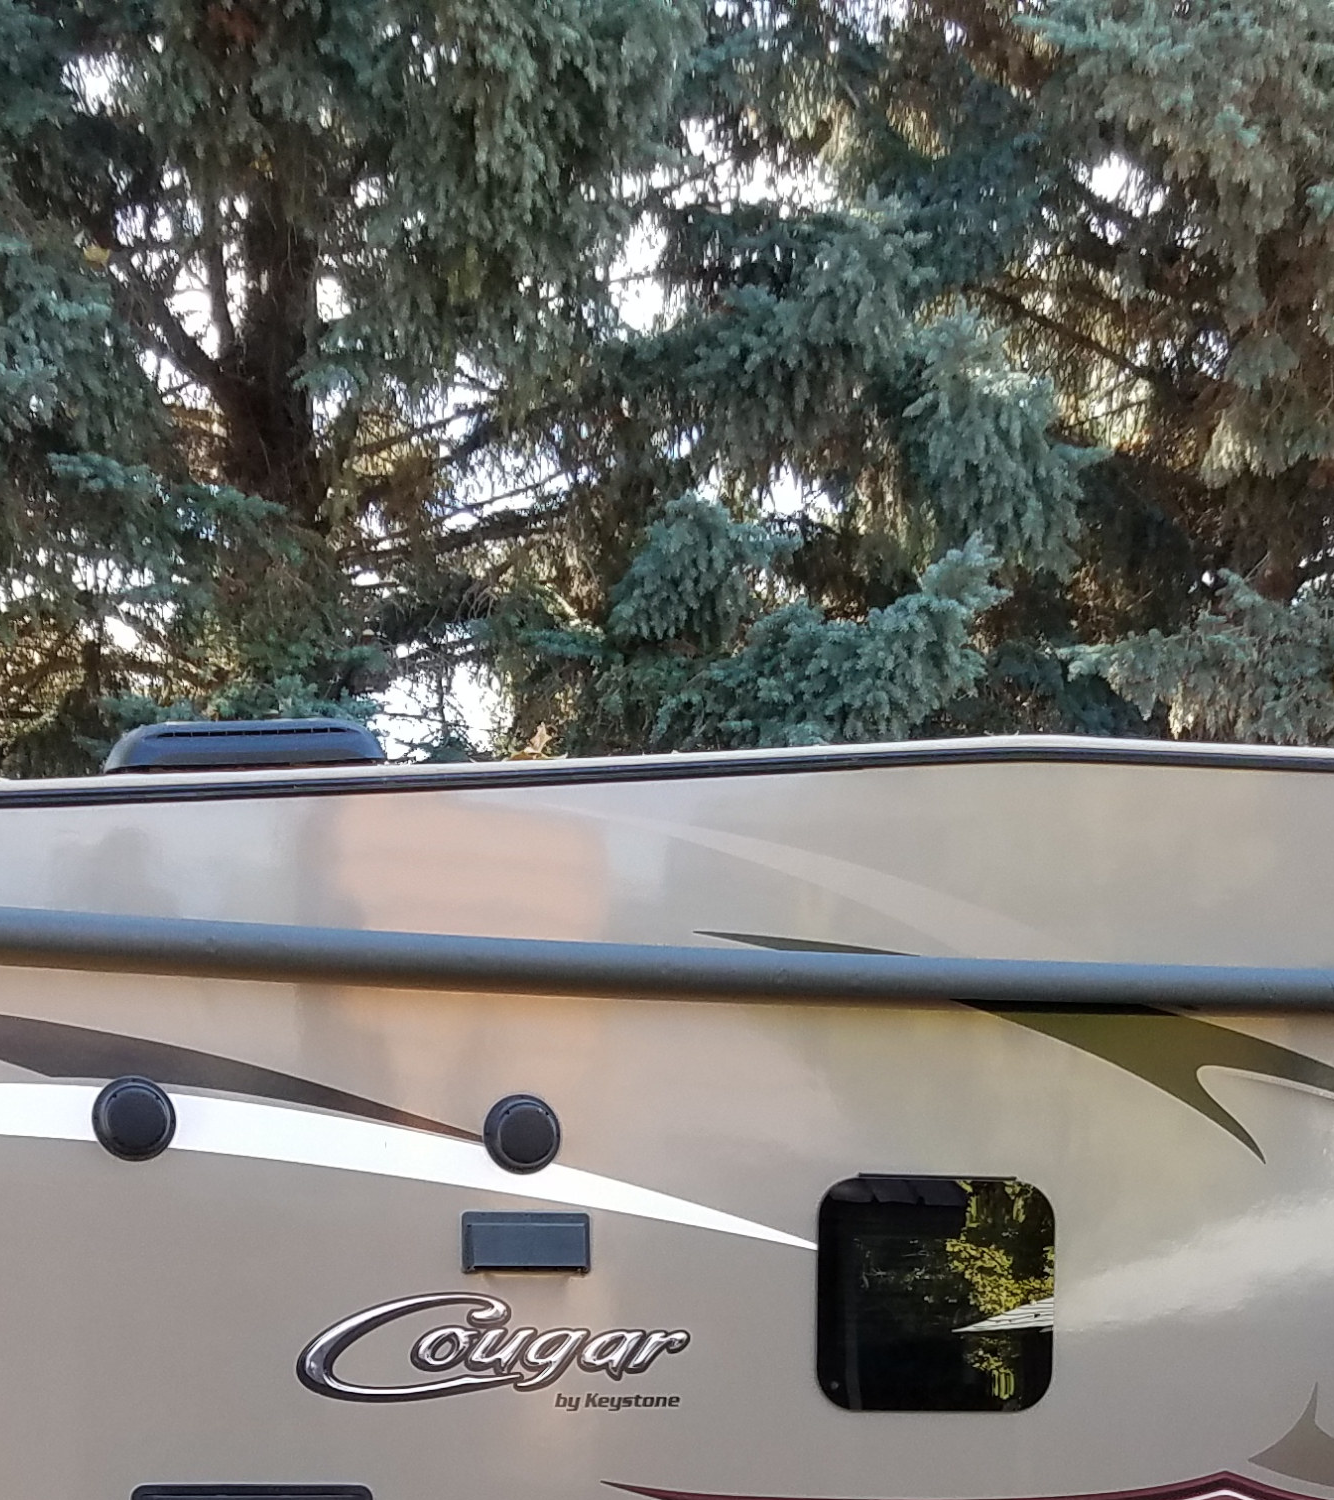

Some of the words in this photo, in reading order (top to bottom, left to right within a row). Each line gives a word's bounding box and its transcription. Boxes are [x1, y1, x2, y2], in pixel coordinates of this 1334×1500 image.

[296, 1291, 691, 1403] Cougar
[555, 1393, 581, 1411] by
[584, 1393, 681, 1411] Keystone
